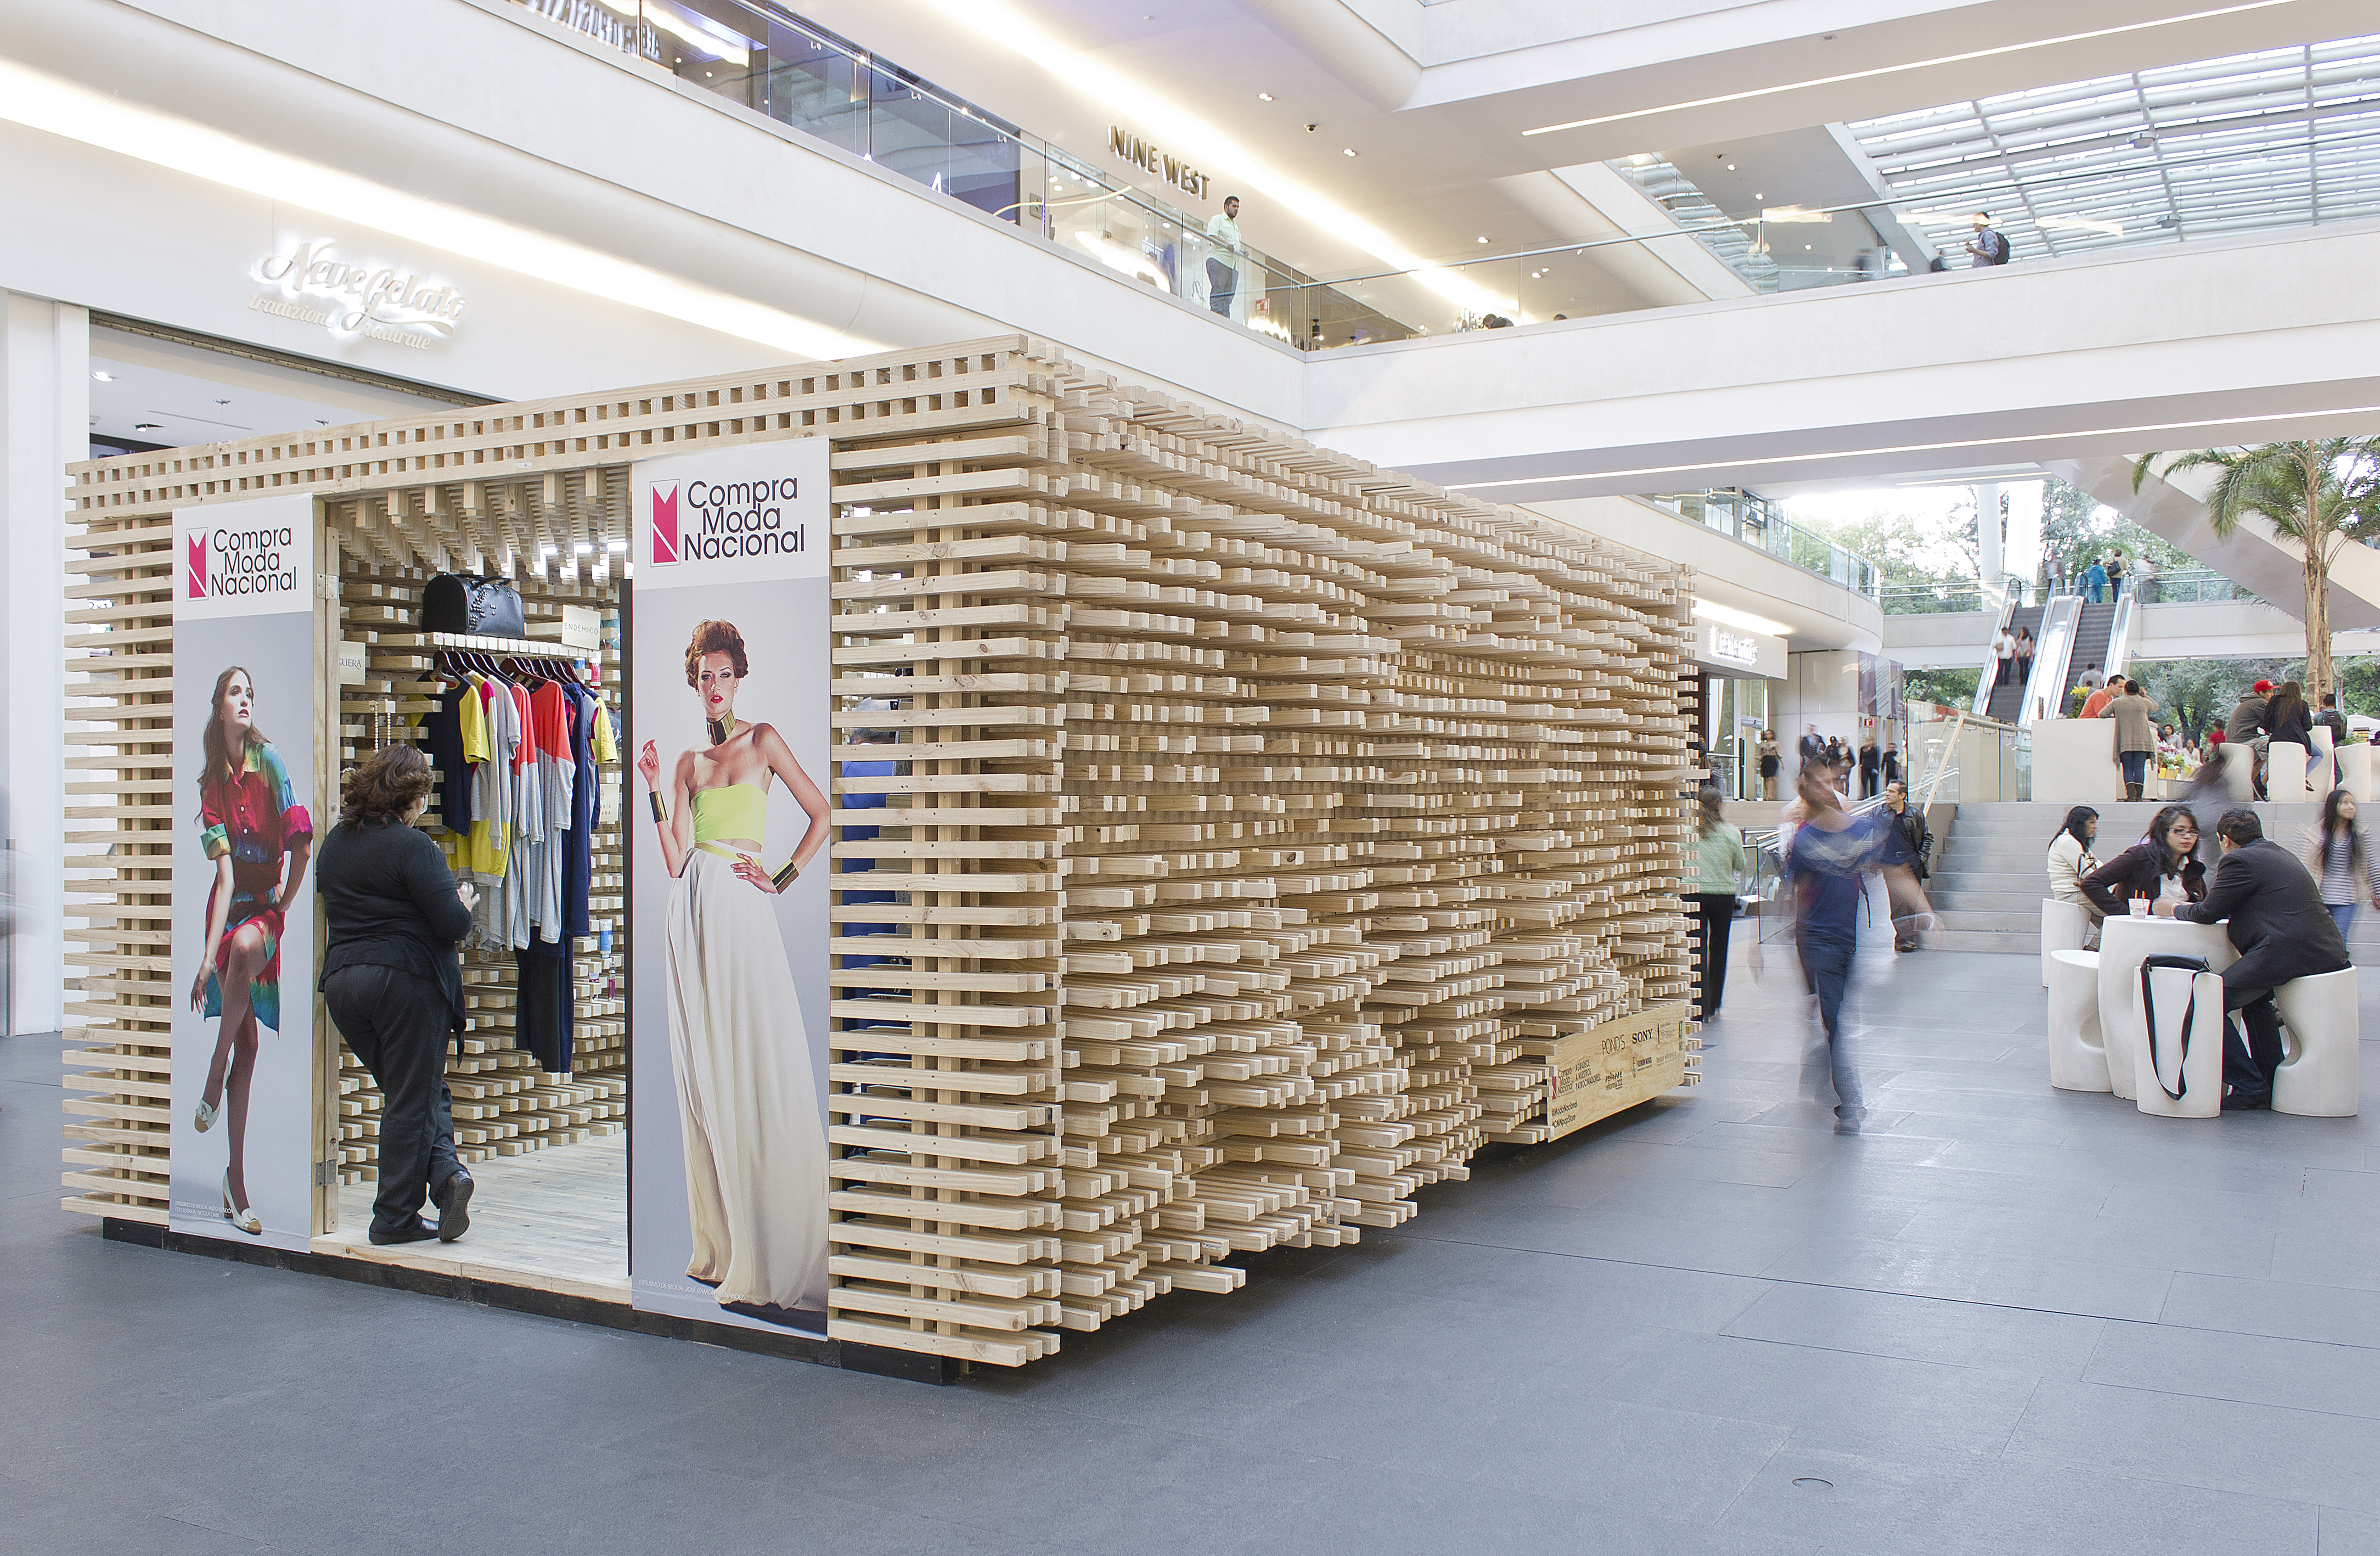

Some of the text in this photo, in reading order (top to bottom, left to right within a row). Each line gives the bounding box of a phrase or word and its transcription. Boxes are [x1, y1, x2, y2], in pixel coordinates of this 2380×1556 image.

[1110, 125, 1210, 200] NINE WEST
[261, 242, 367, 294] Neve
[248, 293, 334, 328] tradizione
[358, 325, 431, 351] naturale
[687, 478, 797, 509] Compra
[703, 503, 780, 536] Moda
[213, 527, 292, 553] Compra
[684, 523, 804, 561] Nacional
[224, 549, 280, 575] Moda
[211, 566, 297, 597] Nacional
[564, 622, 599, 636] ENDÉMICO
[1602, 1034, 1625, 1055] POND'S
[1632, 1029, 1653, 1044] SONY
[1558, 1068, 1572, 1077] Compra
[1559, 1076, 1570, 1086] Moda
[1558, 1082, 1573, 1094] Nacional
[639, 1279, 660, 1288] ESTILISMO
[697, 1288, 716, 1296] RAMÓN
